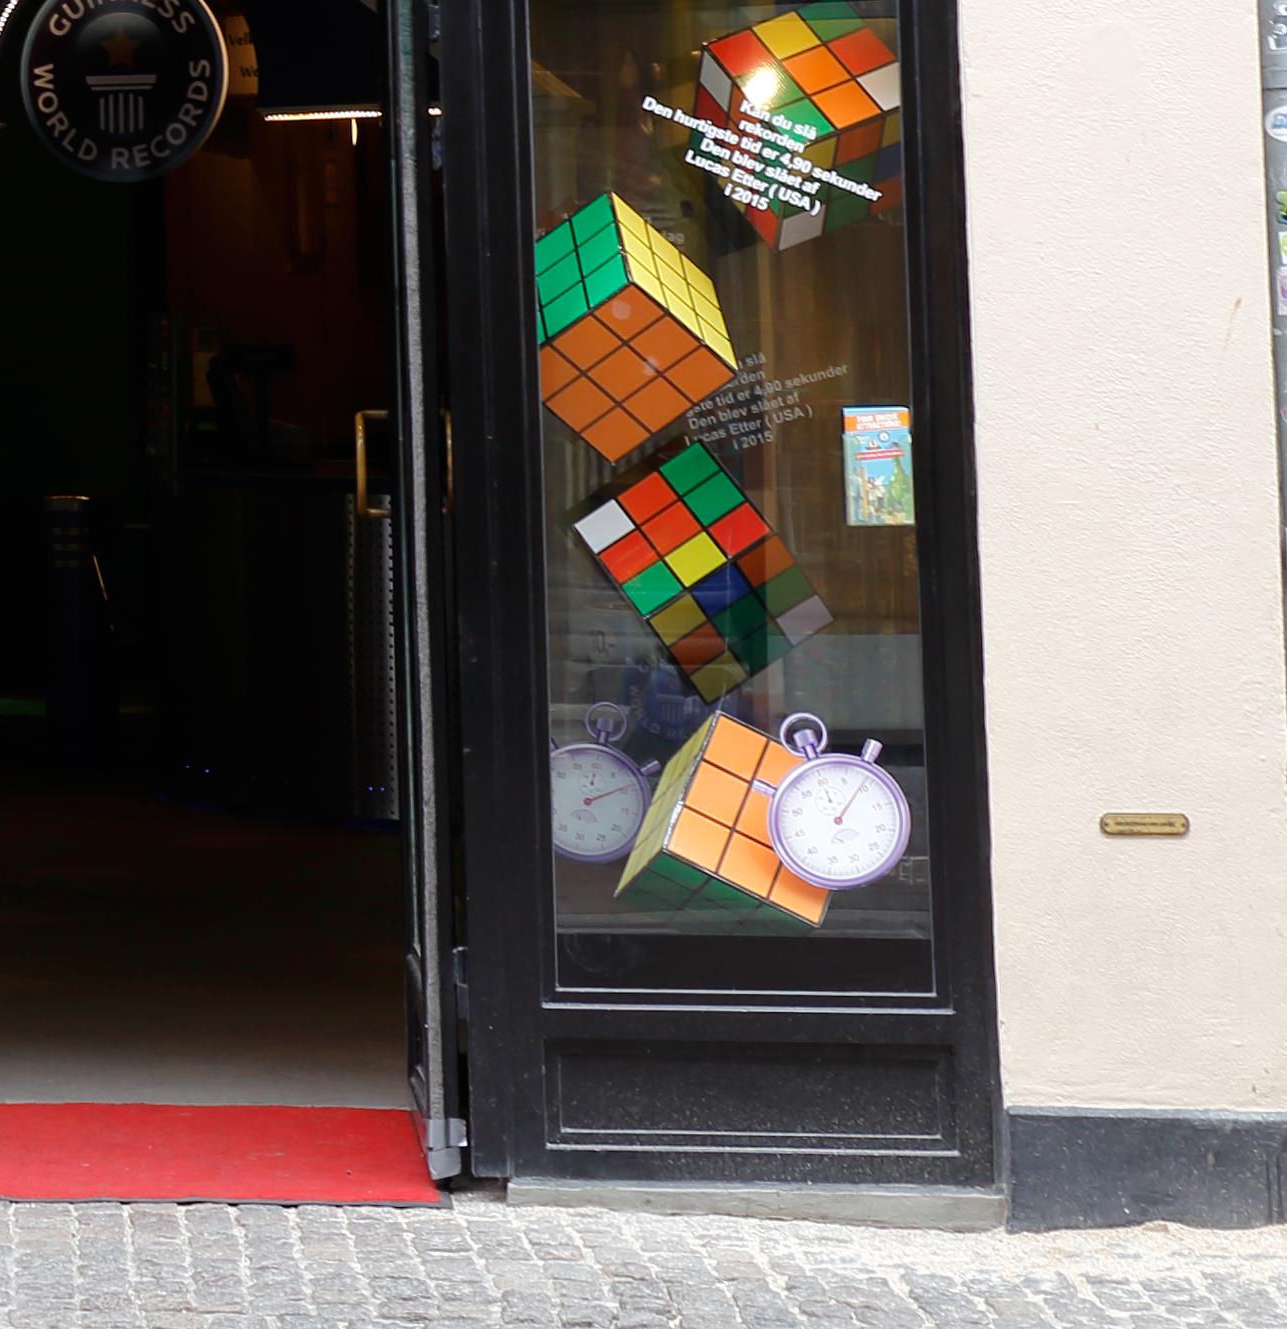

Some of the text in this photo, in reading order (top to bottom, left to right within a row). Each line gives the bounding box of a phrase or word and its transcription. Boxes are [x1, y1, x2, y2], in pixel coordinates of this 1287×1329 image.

[33, 59, 211, 170] WORLD RECORDS
[738, 119, 805, 153] rekorden
[739, 99, 817, 140] Kan du slå
[642, 96, 673, 119] Den
[673, 109, 739, 144] hurtigste
[740, 137, 762, 154] tid
[761, 148, 780, 160] er
[811, 167, 883, 202] sekunder
[685, 149, 731, 177] Lucas
[731, 167, 770, 192] Etter
[700, 137, 731, 160] Den
[731, 150, 765, 172] blev
[801, 181, 821, 195] af
[731, 187, 770, 211] 2015
